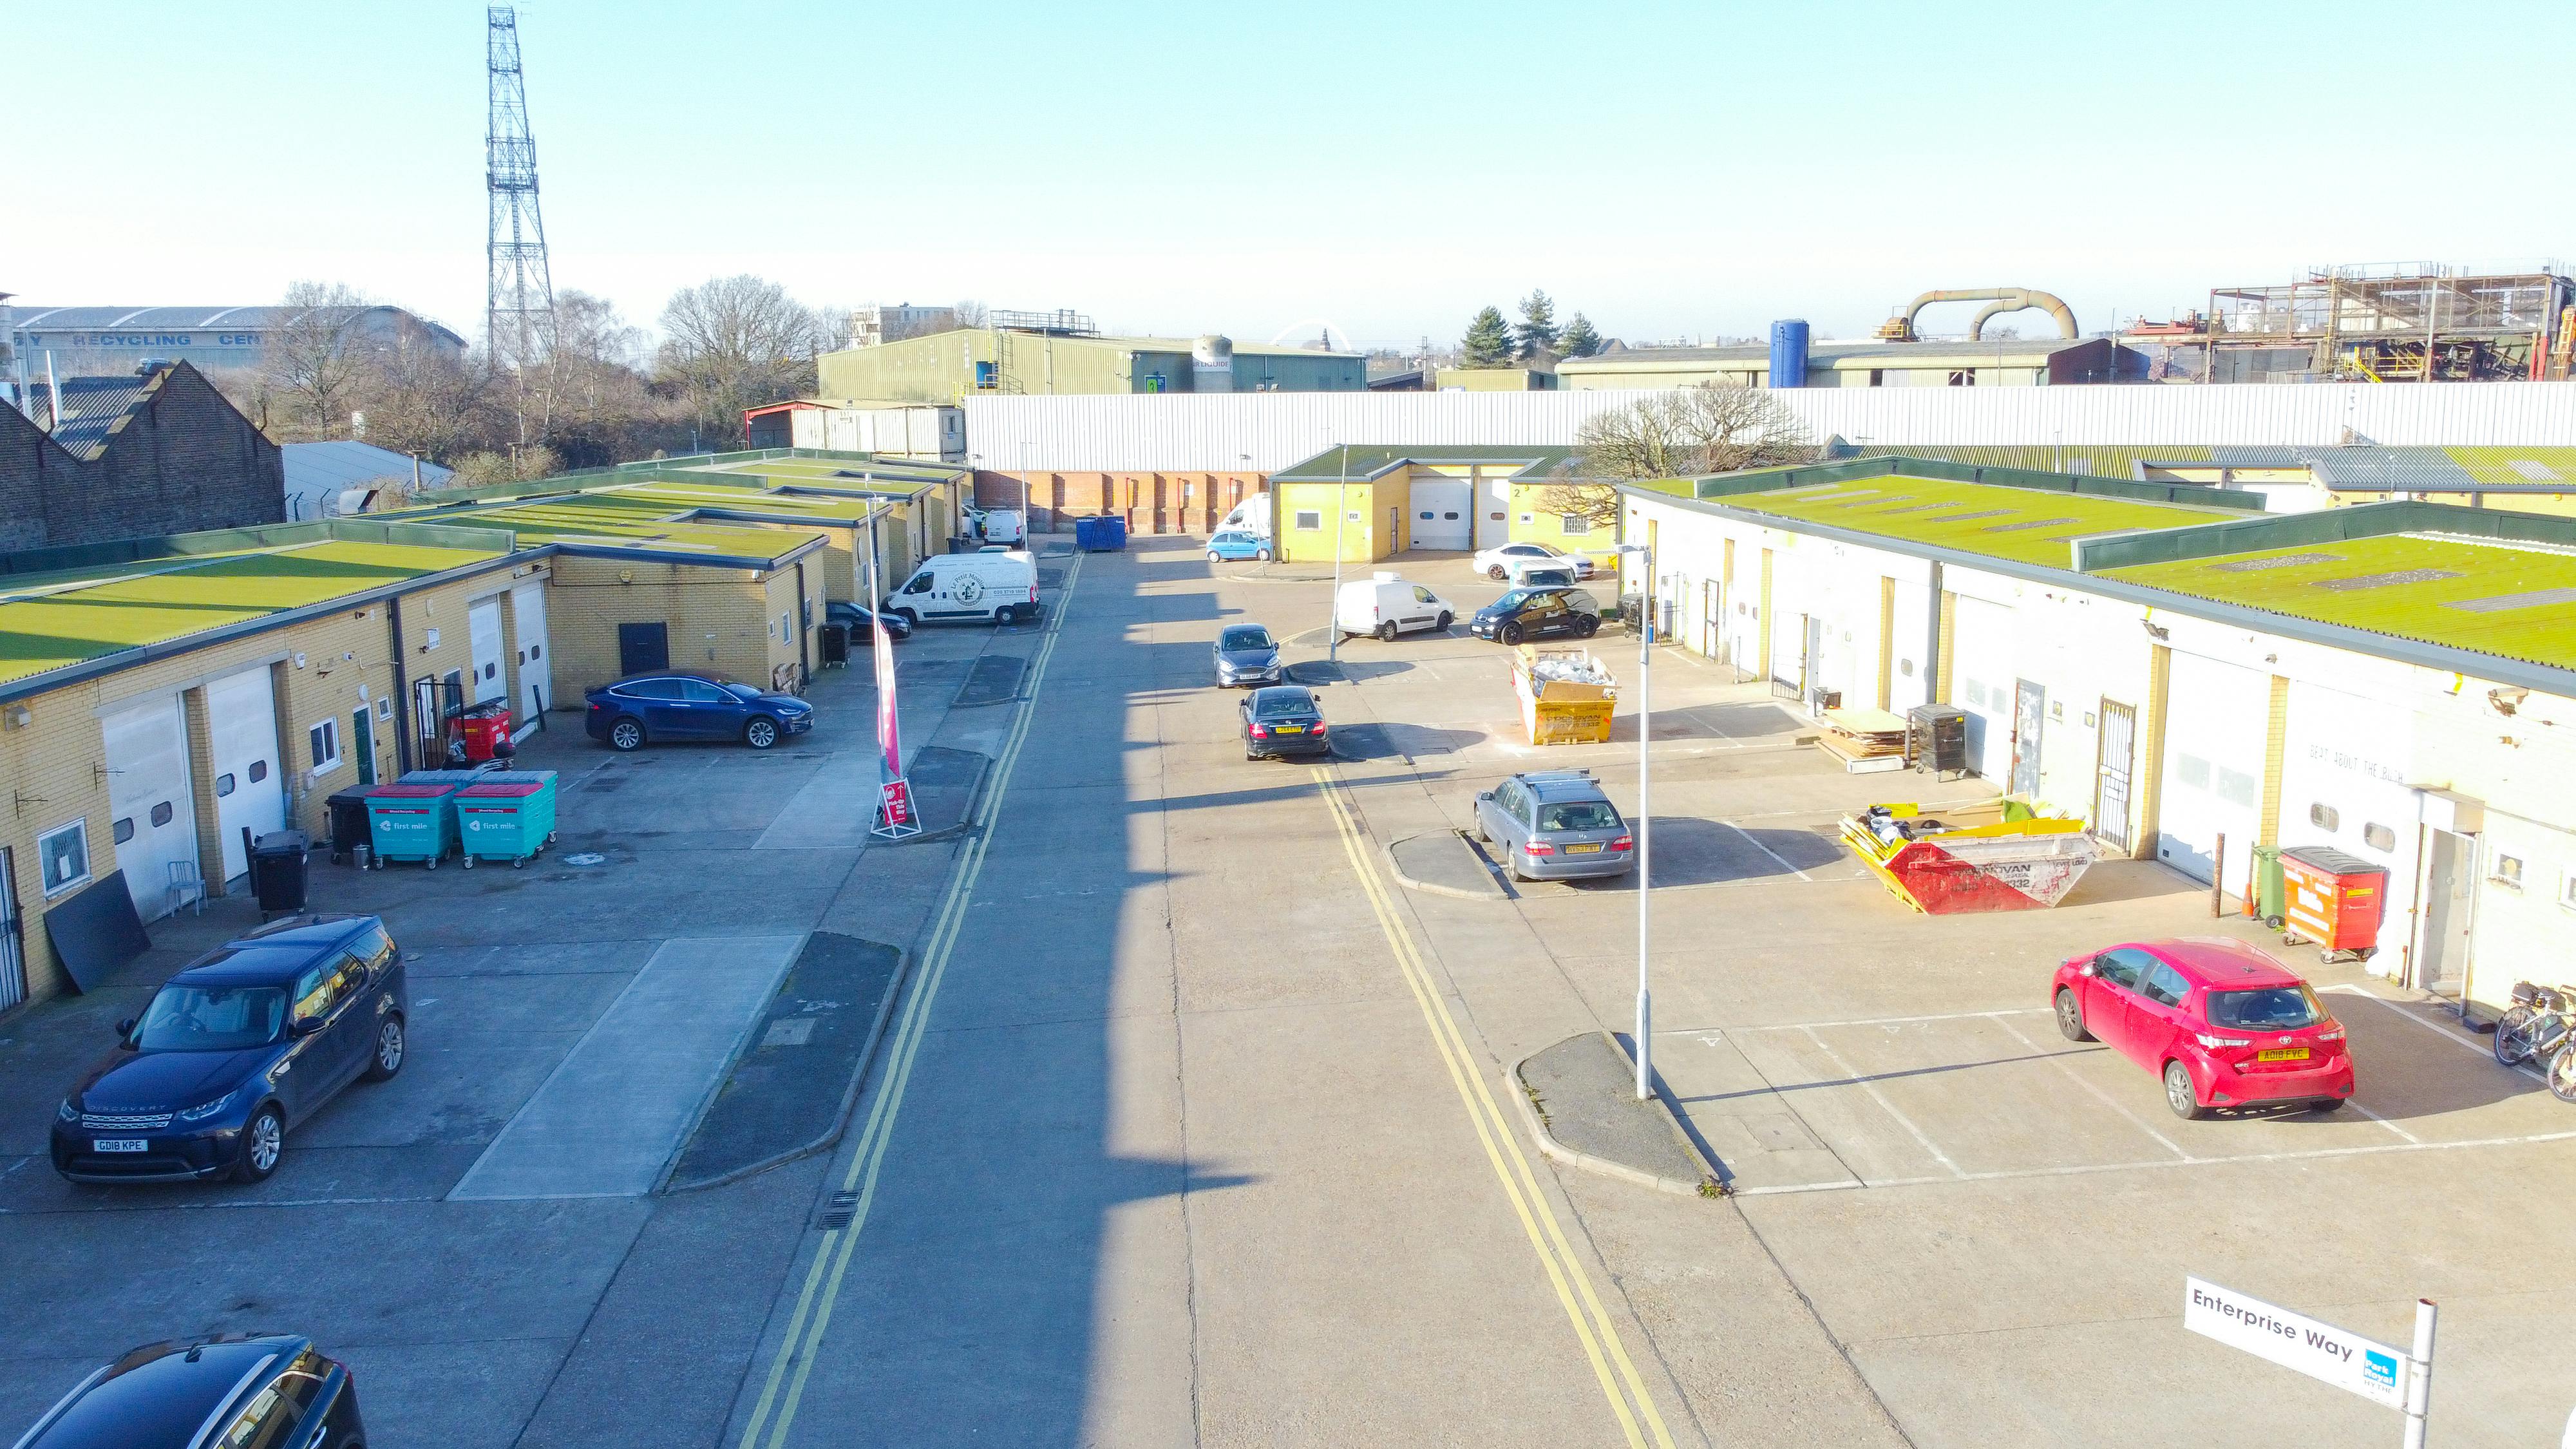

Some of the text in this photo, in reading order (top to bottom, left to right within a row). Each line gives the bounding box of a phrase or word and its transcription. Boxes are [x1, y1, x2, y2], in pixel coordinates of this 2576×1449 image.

[73, 335, 191, 346] RECYCLING
[1514, 489, 1520, 497] 2
[2334, 752, 2357, 770] ABOUT
[2365, 761, 2377, 777] THE
[99, 1141, 142, 1150] GD18 KPE
[2193, 1289, 2353, 1362] Enterprise Way
[2365, 1359, 2389, 1374] Park
[2364, 1368, 2394, 1385] Royal
[2364, 1380, 2391, 1394] HYTHE
